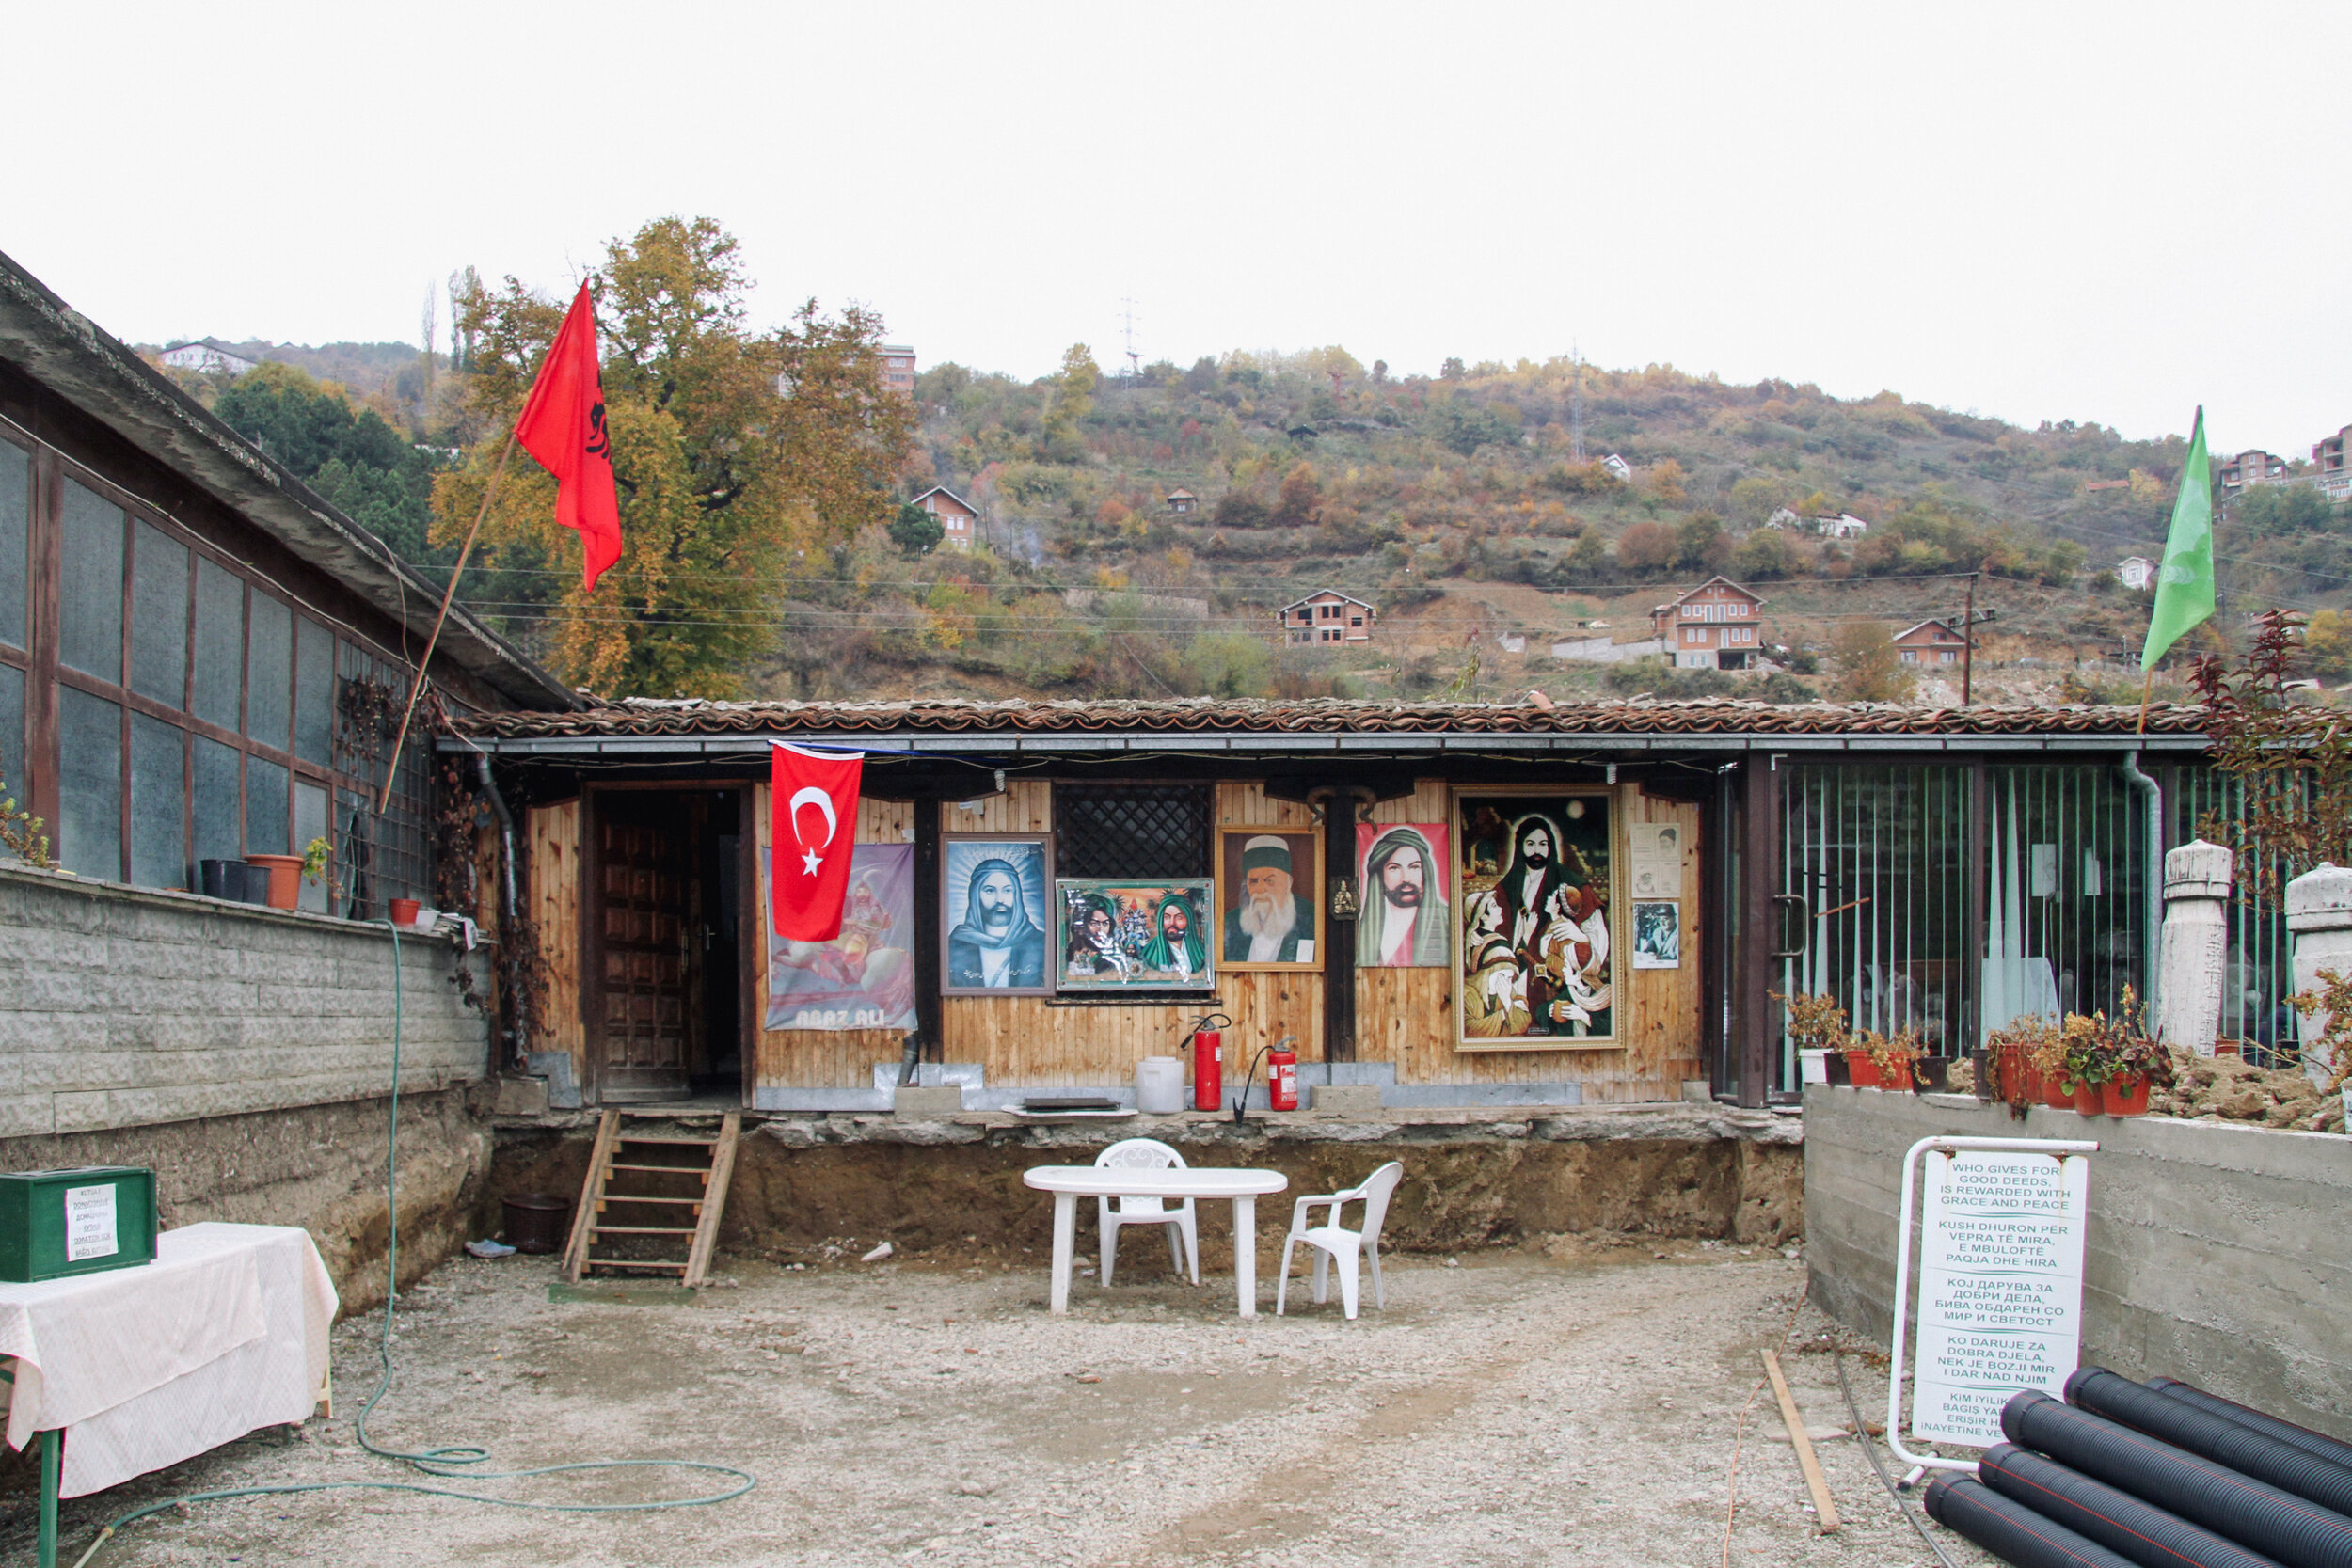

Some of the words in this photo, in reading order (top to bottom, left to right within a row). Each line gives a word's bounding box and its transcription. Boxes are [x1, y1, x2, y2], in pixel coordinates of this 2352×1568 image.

[855, 1009, 884, 1026] ALI
[1952, 1164, 1983, 1173] WHO
[1988, 1165, 2027, 1174] GIVES
[1959, 1175, 1998, 1184] GOOD
[1957, 1186, 2032, 1196] REWARDED
[1941, 1196, 1987, 1206] GRACE
[2024, 1200, 2070, 1210] PEACE
[1939, 1221, 1975, 1229] KUSH
[1979, 1223, 2036, 1232] DHURON
[2041, 1225, 2068, 1234] PËR
[1949, 1232, 1993, 1242] VEPRA
[1998, 1234, 2013, 1243] TË
[1960, 1243, 1966, 1252] E
[1972, 1244, 2043, 1256] MBULOFTË
[1947, 1254, 1989, 1264] PAQJA
[1994, 1257, 2020, 1265] DHE
[2025, 1259, 2057, 1267] HIRA
[1947, 1279, 1973, 1288] КОЈ
[1978, 1281, 2031, 1291] ДАРУВА
[2036, 1284, 2053, 1292] ЗА
[1953, 1291, 2000, 1300] ДОБРИ
[1935, 1300, 1970, 1309] БИВА
[1975, 1303, 2040, 1314] ОБДАРЕН
[1945, 1311, 1972, 1321] МИР
[1990, 1315, 2054, 1325] СВЕТОСТ
[1947, 1337, 1966, 1345] KO
[1971, 1338, 2024, 1349] DARUJE
[2028, 1342, 2045, 1351] ZA
[1947, 1347, 1994, 1358] DOBRA
[1938, 1357, 1963, 1366] NEK
[1988, 1361, 2026, 1371] BOZJI
[2031, 1365, 2055, 1373] MIR
[1951, 1370, 1979, 1378] DAR
[1983, 1372, 2010, 1381] NAD
[2015, 1374, 2046, 1384] NJIM
